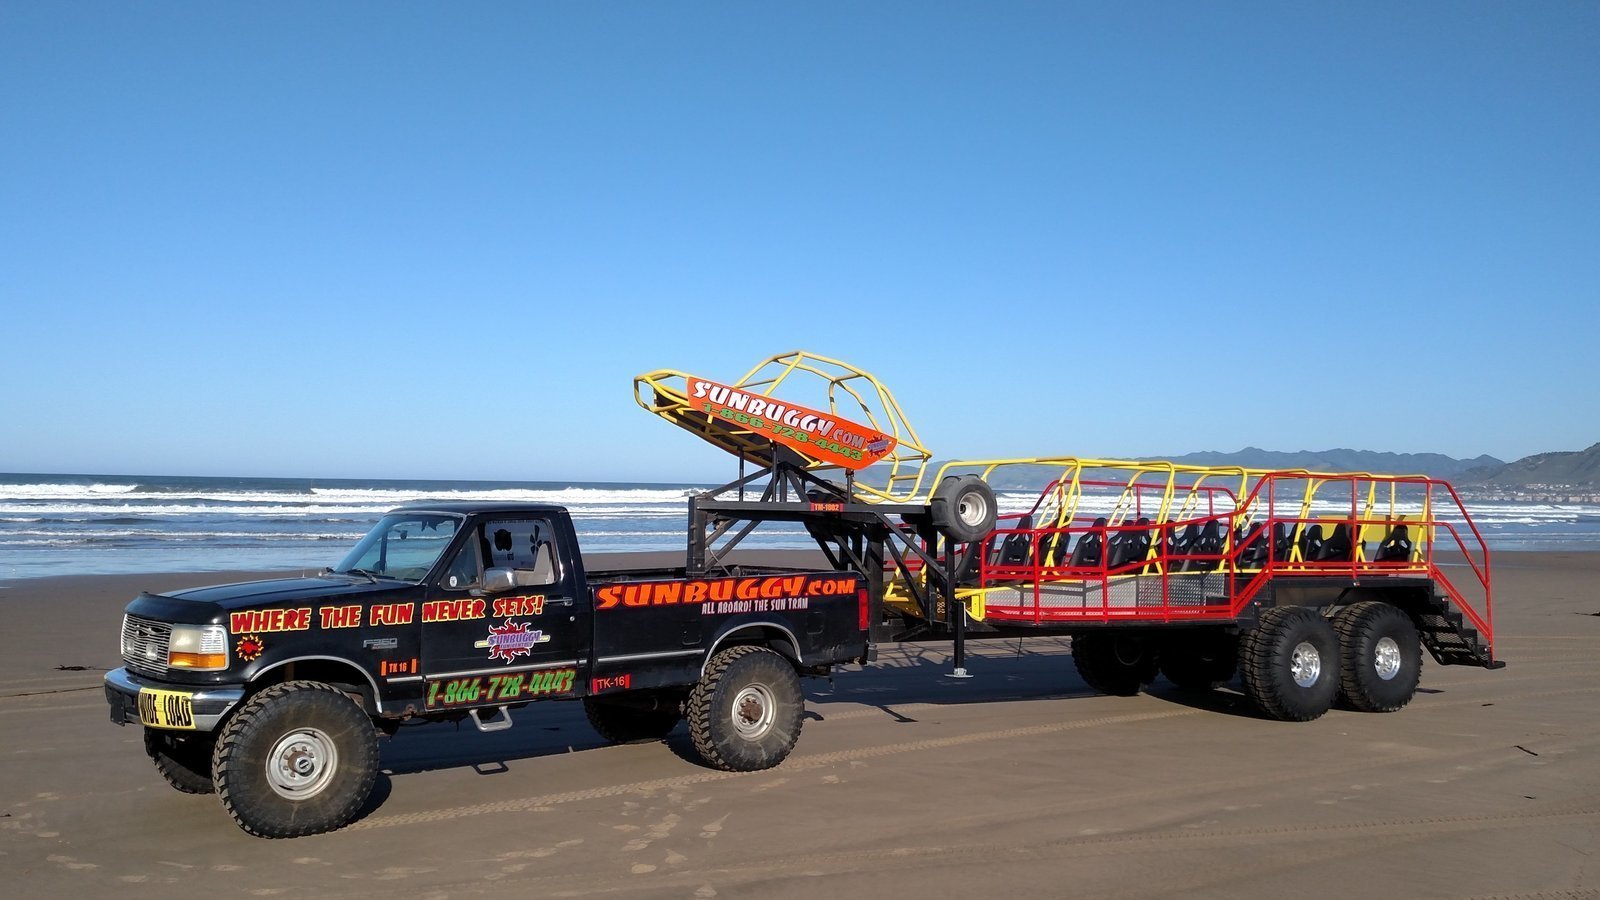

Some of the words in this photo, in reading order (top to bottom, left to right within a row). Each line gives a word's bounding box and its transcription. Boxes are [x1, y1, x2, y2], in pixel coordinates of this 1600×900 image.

[693, 381, 866, 449] SUNBUGGY.COM
[702, 403, 863, 461] 1-866-728-4443
[597, 575, 856, 609] SUNBUGGY.COM
[701, 601, 716, 615] ALL
[717, 600, 752, 614] ABOARD!
[754, 599, 769, 611] THE
[770, 598, 786, 611] SUN
[787, 597, 809, 610] TRAM
[230, 608, 312, 634] WHERE
[319, 605, 362, 629] THE
[370, 603, 415, 626] FUN
[422, 599, 486, 623] NEVER
[493, 595, 545, 617] SETS!
[488, 631, 541, 645] SUNBUGGY
[399, 662, 407, 672] 16
[598, 675, 625, 690] TK-16
[427, 668, 576, 707] 1-866-728-4443
[140, 692, 160, 725] WIDE
[163, 694, 192, 727] LOAD
